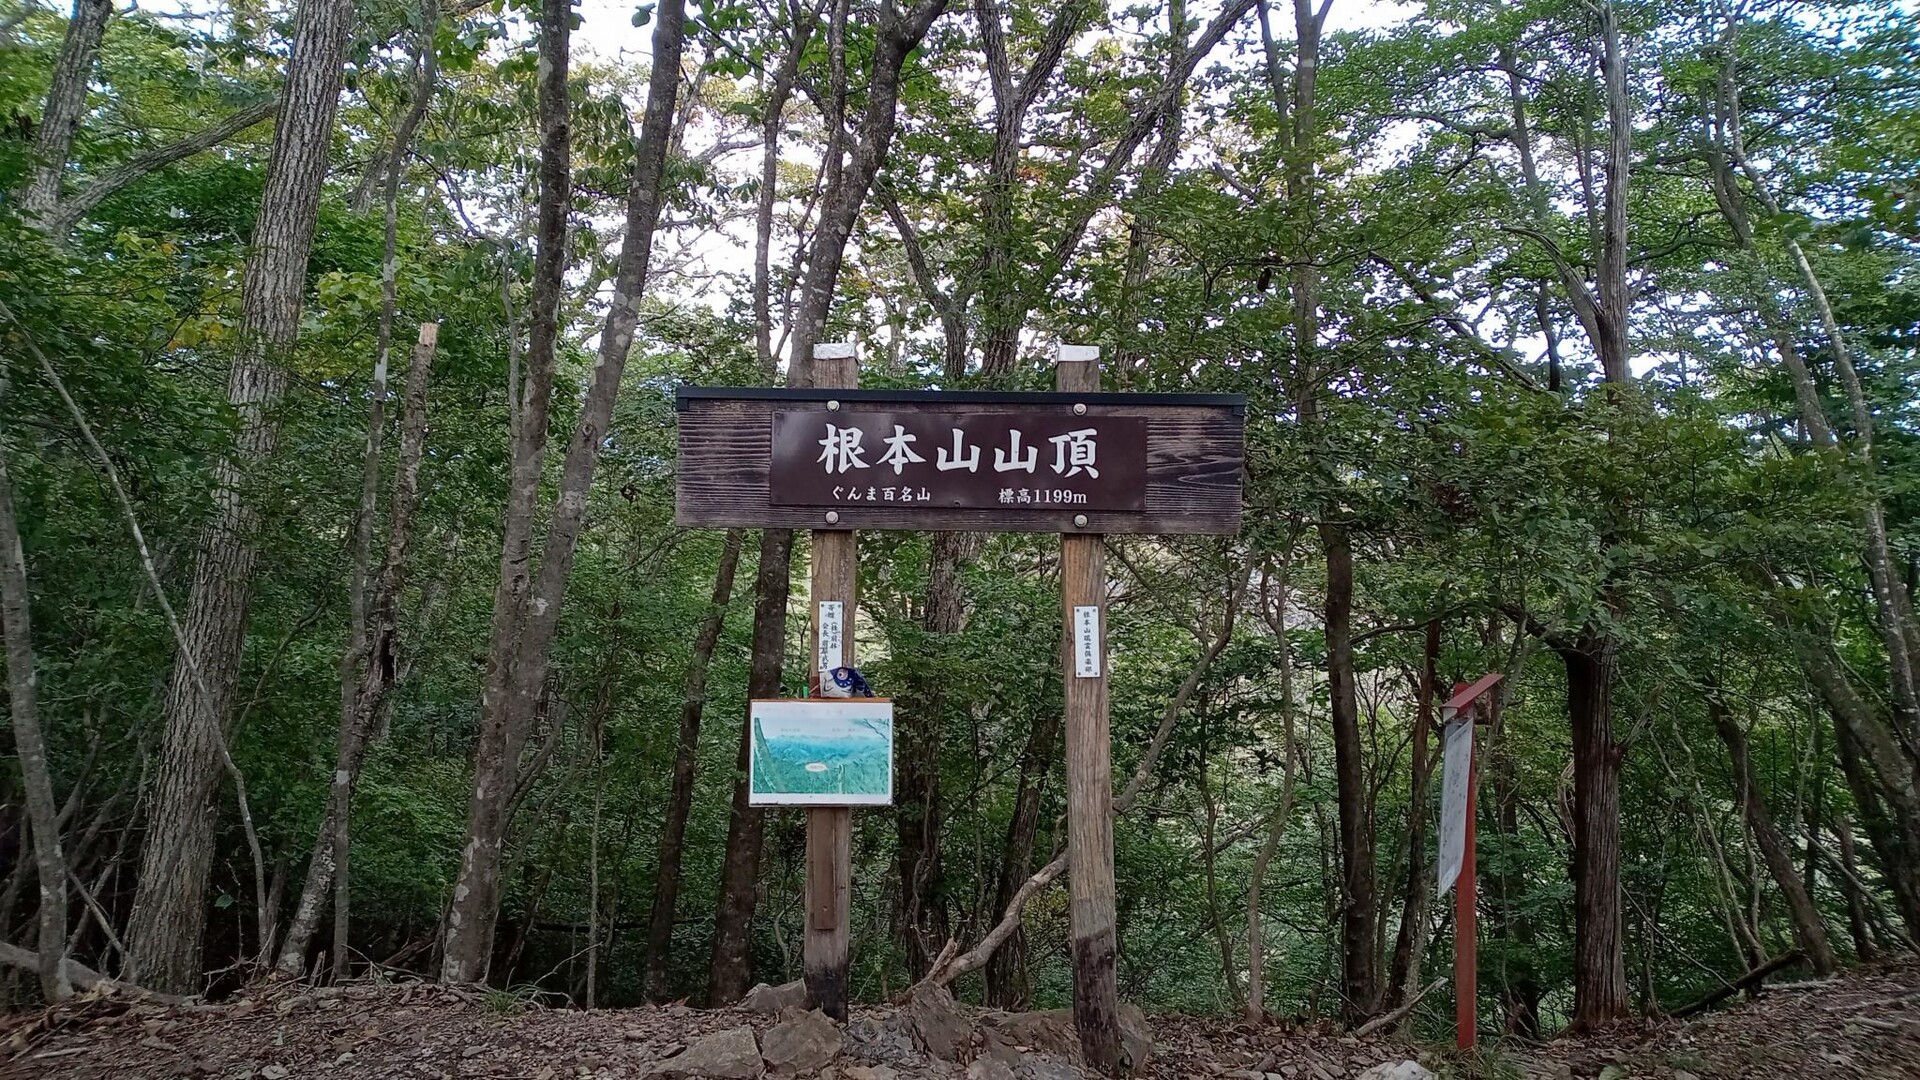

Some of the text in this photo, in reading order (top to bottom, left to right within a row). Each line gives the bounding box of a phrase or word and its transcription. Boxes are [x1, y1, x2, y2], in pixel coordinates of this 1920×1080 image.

[817, 423, 1100, 479] 根本山山頂
[832, 487, 931, 502] ぐんま百名山
[998, 488, 1087, 504] 標高1199m
